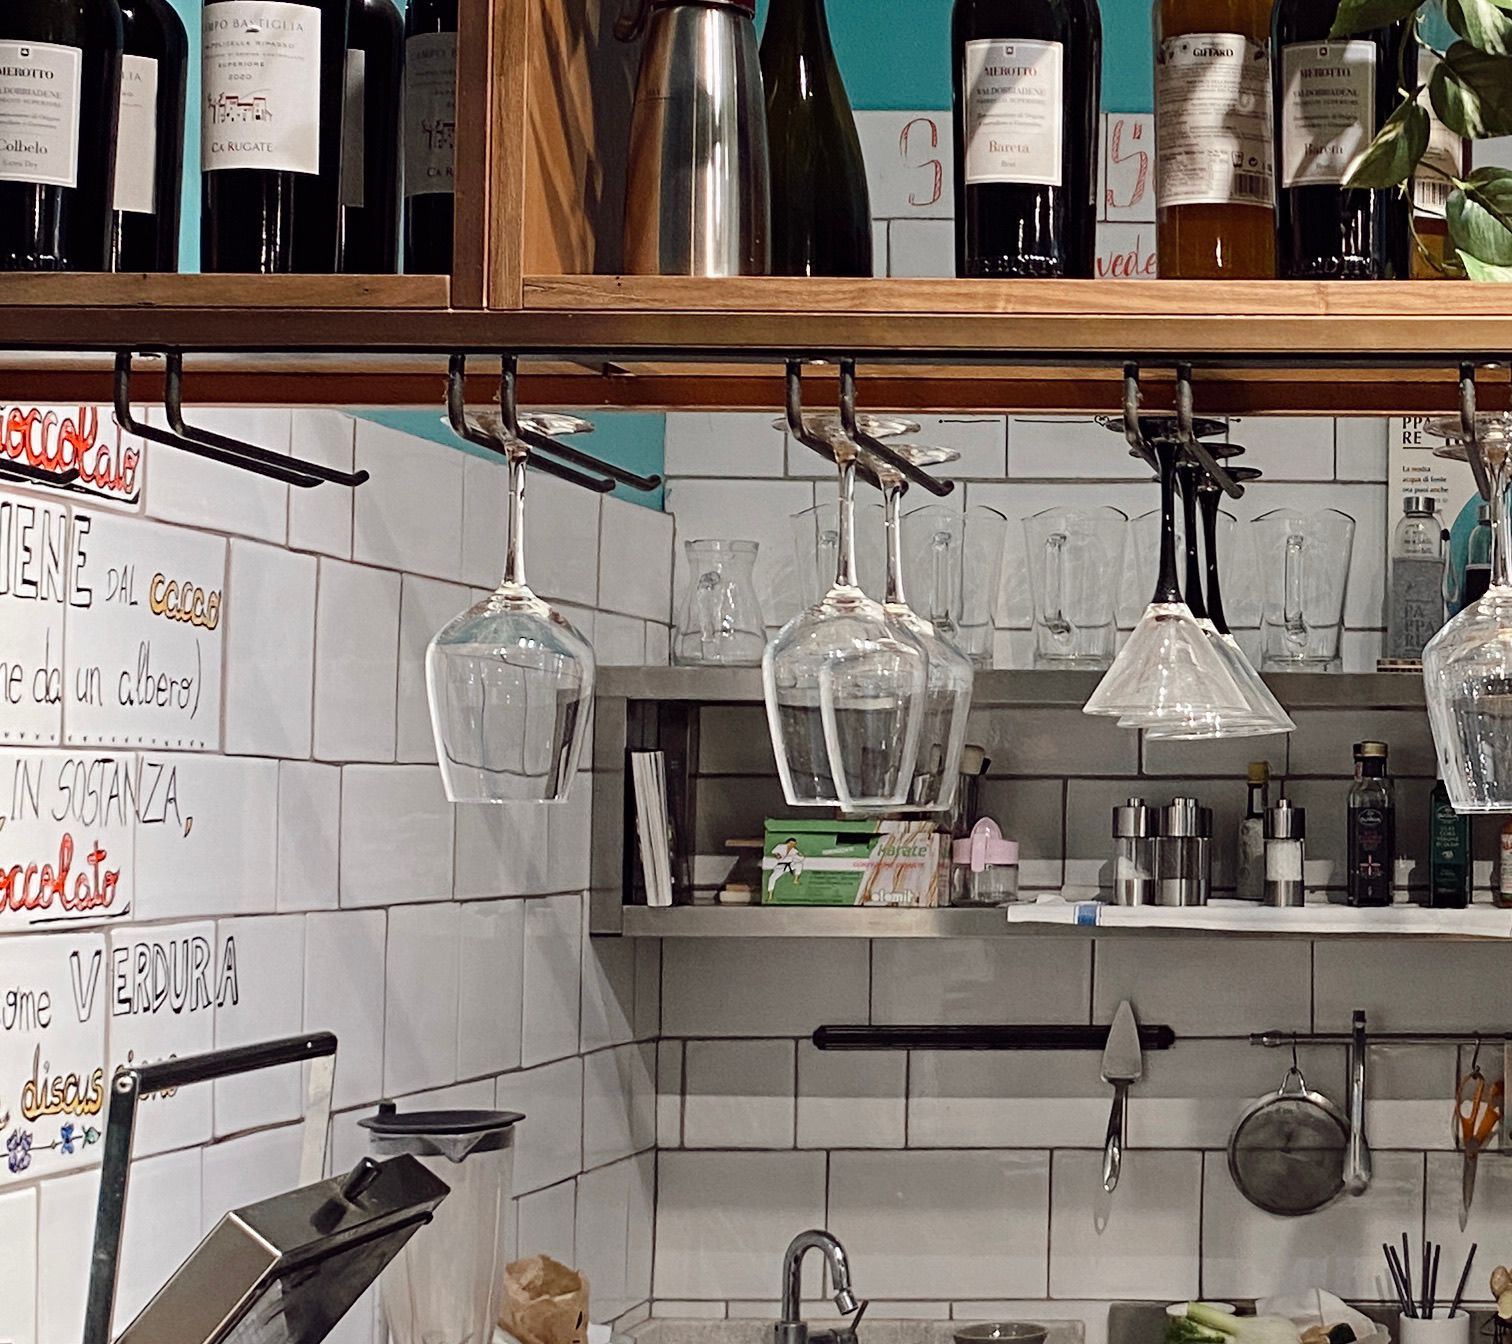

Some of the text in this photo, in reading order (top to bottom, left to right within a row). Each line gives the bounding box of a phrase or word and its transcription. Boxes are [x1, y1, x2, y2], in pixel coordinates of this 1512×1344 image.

[1192, 47, 1235, 58] GIFFARD
[984, 65, 1038, 77] MEROTTO
[1299, 67, 1352, 80] MEROTTO
[227, 141, 274, 153] RUGATE
[0, 406, 141, 495] occolato
[1401, 430, 1423, 446] RE
[105, 564, 139, 606] DAL
[150, 572, 223, 631] cacao
[75, 664, 104, 707] un
[10, 757, 44, 822] IN
[69, 935, 240, 1024] VERDURA
